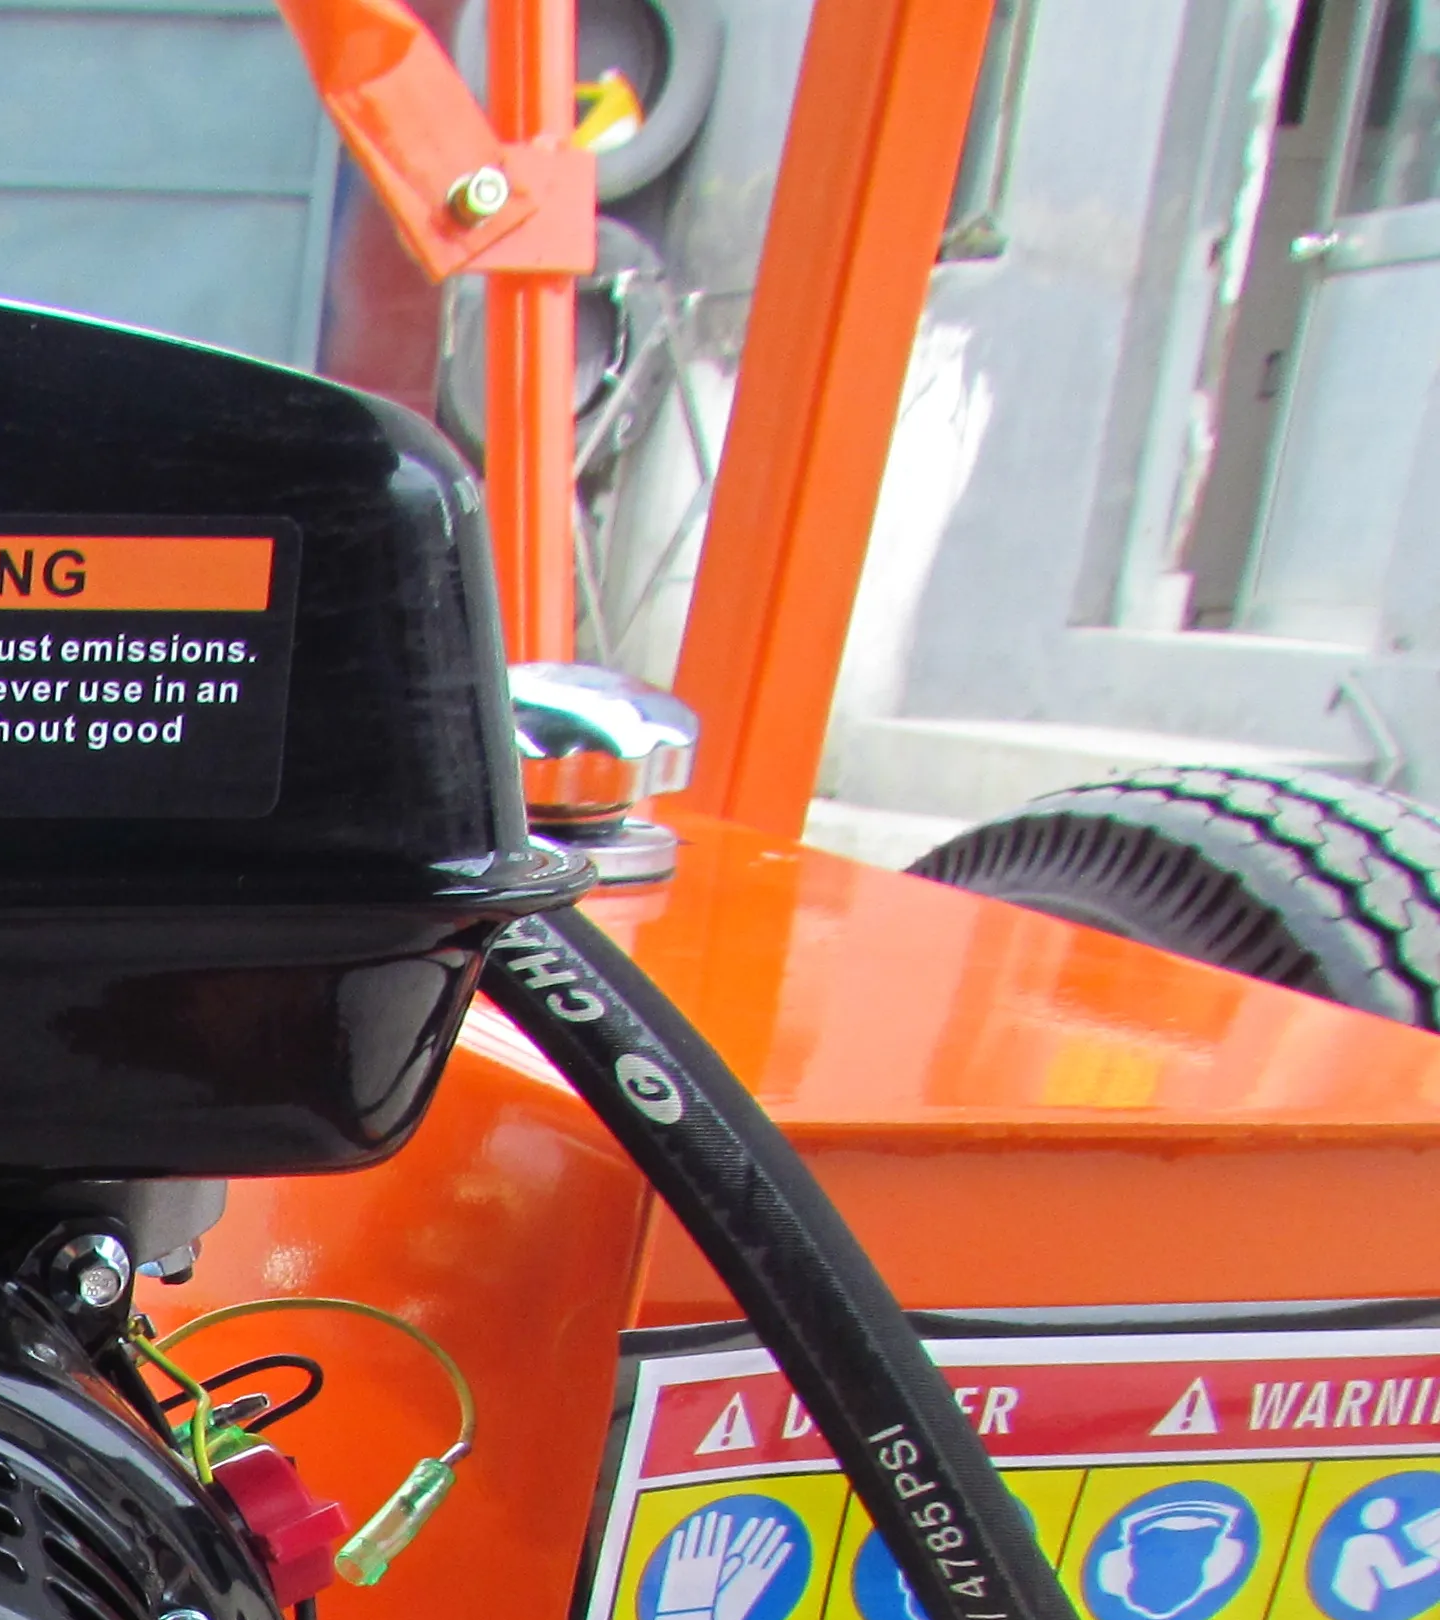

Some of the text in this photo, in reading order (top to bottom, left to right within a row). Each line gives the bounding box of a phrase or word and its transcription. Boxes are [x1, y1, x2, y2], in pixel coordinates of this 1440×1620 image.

[60, 633, 257, 664] emissions.
[79, 679, 143, 702] use
[154, 675, 186, 703] in
[196, 680, 239, 703] an
[87, 714, 184, 750] good
[1249, 1377, 1440, 1431] WARNI
[868, 1423, 938, 1500] PSI
[911, 1501, 987, 1597] 4785
